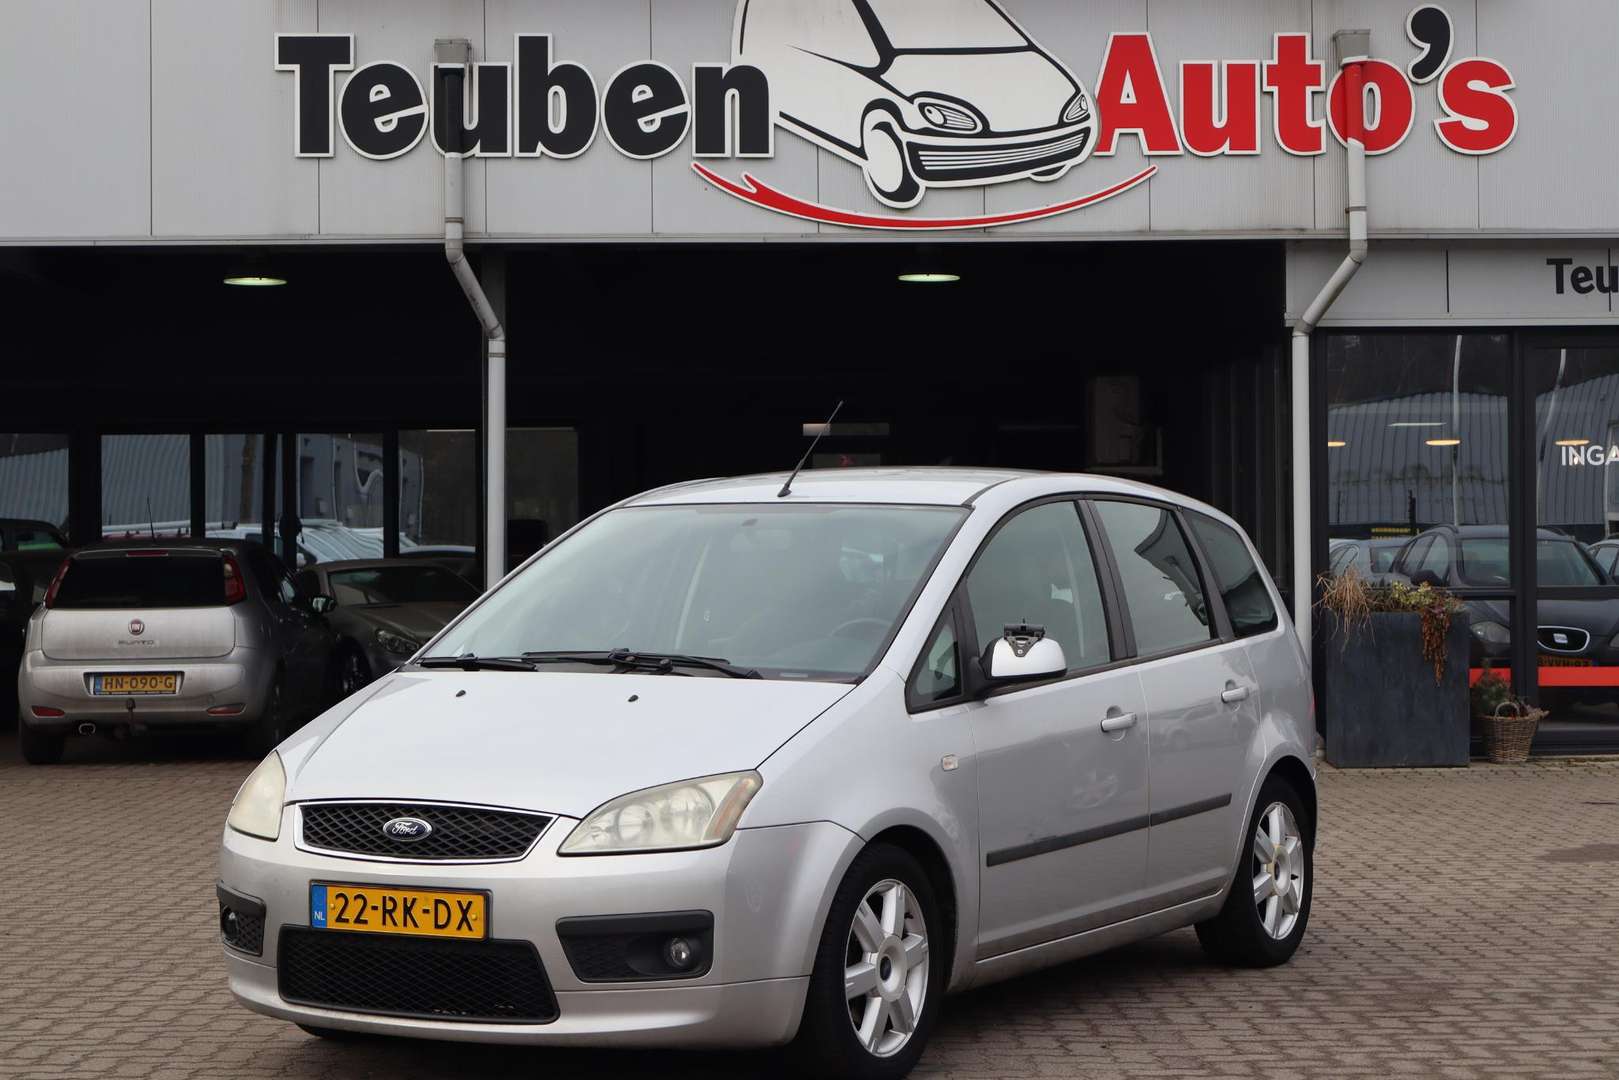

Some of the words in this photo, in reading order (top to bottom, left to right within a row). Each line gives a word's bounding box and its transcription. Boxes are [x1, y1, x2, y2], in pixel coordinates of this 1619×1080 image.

[275, 33, 774, 160] Teuben
[1093, 4, 1519, 157] Auto's
[1546, 258, 1619, 294] Teu
[104, 675, 173, 689] HN-090-G
[391, 821, 418, 835] Ford
[314, 911, 326, 921] NL
[335, 892, 474, 932] 22-RK-DX
